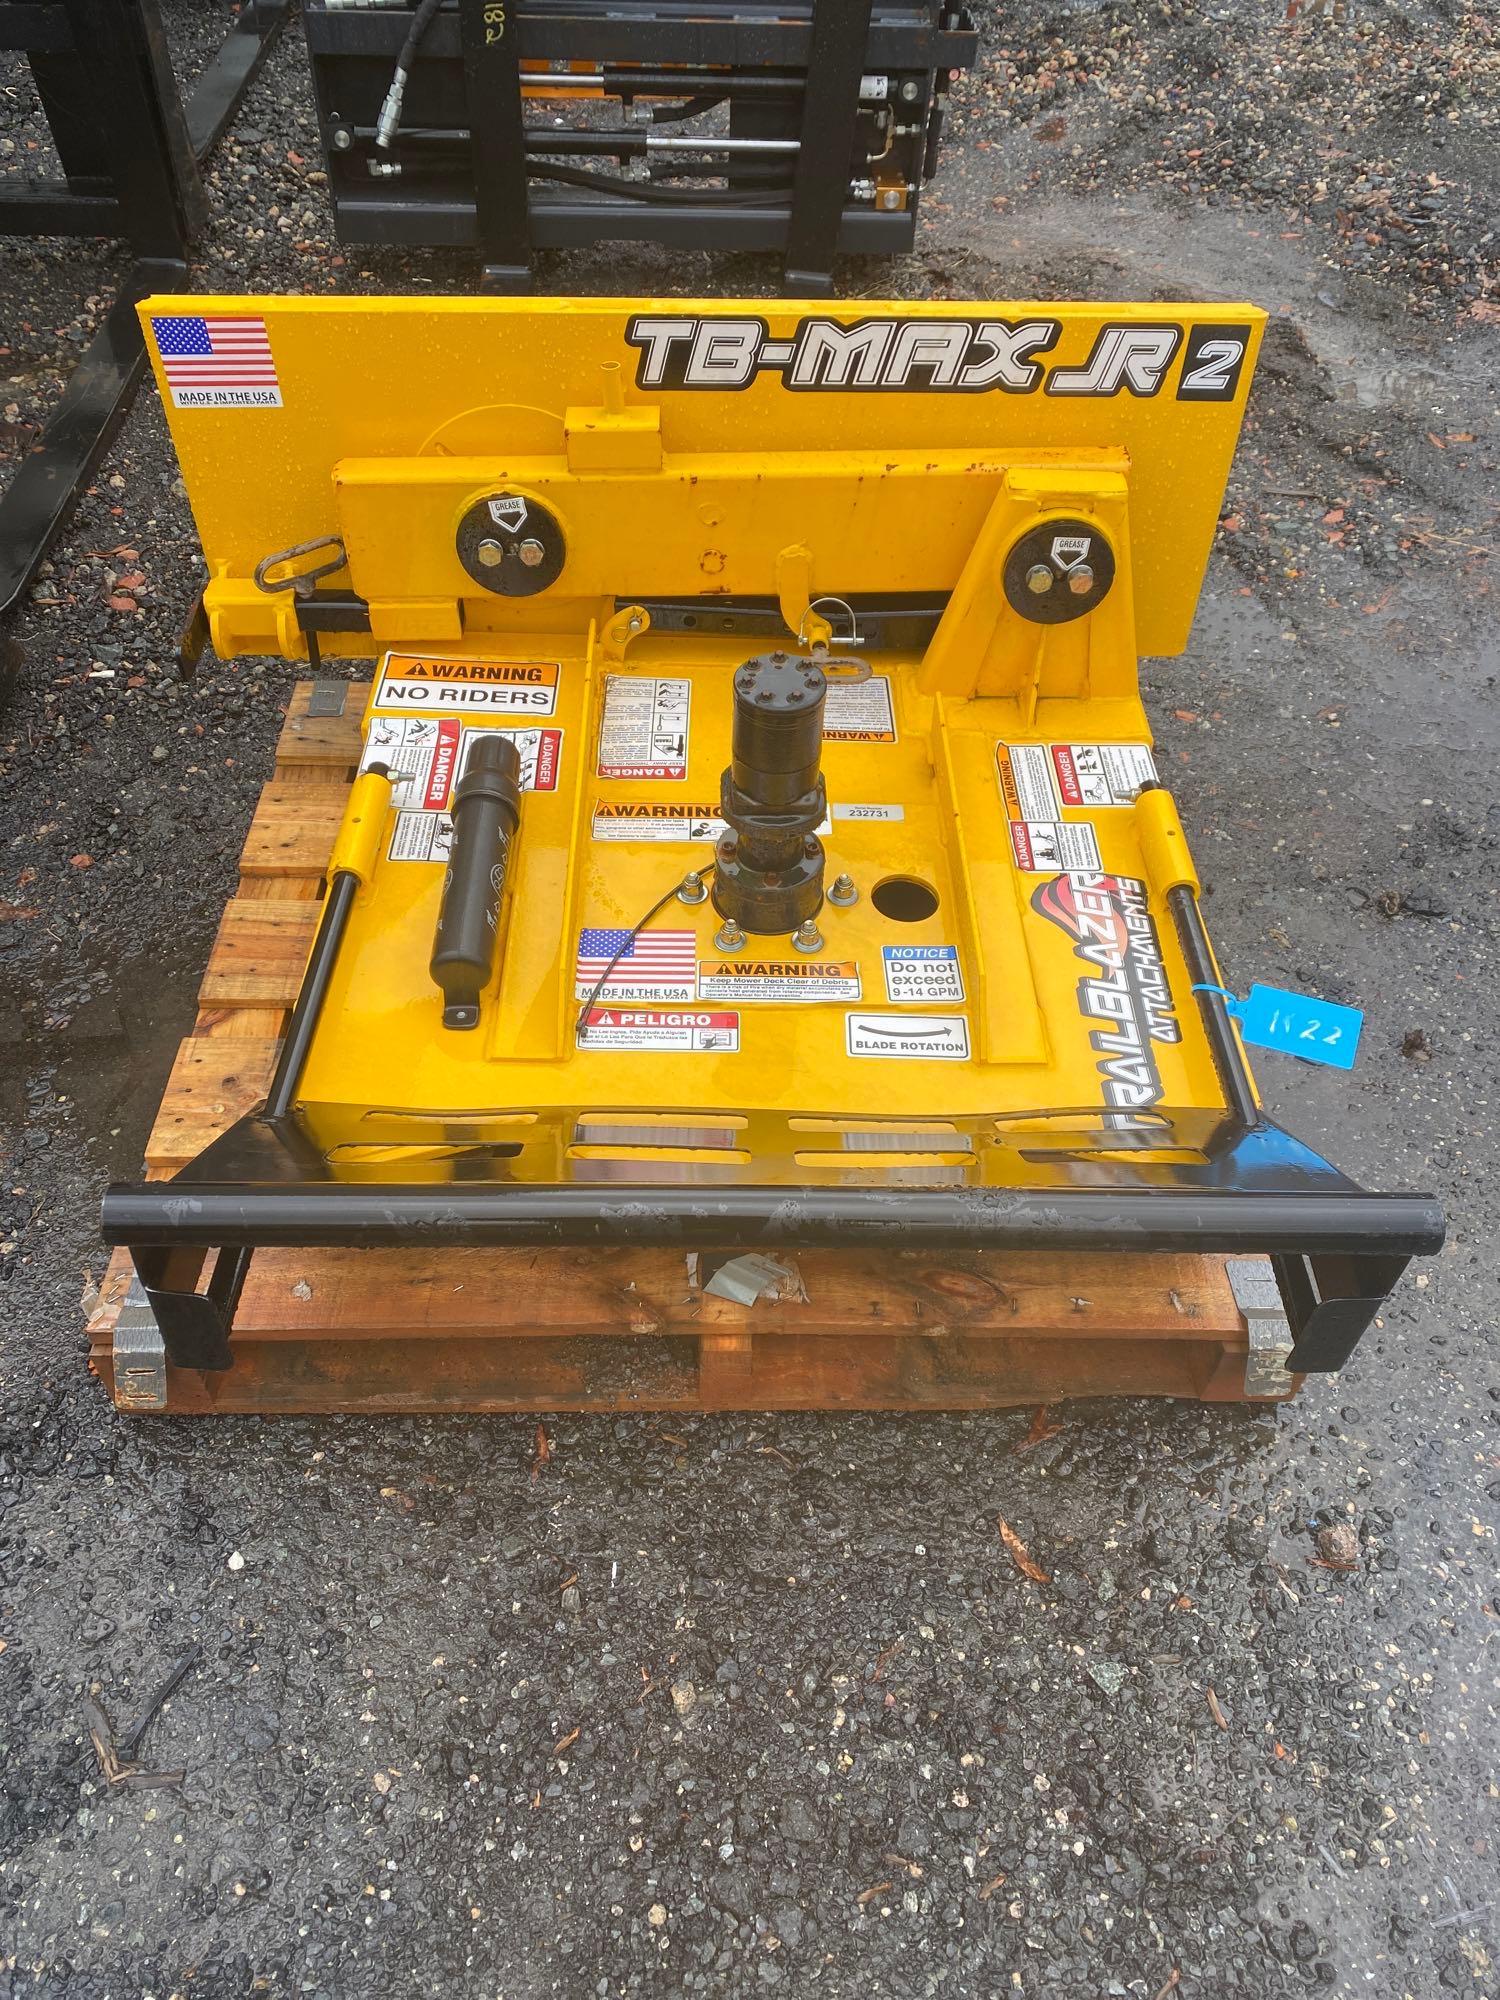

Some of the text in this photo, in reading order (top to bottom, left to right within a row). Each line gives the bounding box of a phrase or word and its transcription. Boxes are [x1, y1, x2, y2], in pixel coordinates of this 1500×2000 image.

[631, 317, 1243, 393] TB-MAX JR 2
[179, 391, 276, 401] MADE IN THE USA
[495, 501, 521, 511] GREASE
[1060, 540, 1086, 549] GREASE
[432, 664, 543, 682] WARNING
[386, 686, 549, 706] NO RIDERS
[540, 744, 554, 784] DANGER
[1058, 751, 1077, 790] DANGER
[429, 747, 453, 801] DANGER
[1001, 760, 1016, 799] WARNING
[1015, 825, 1029, 860] DANGER
[891, 948, 949, 958] NOTICE
[1117, 877, 1176, 1043] ATTACHMENTS
[734, 963, 841, 977] WARNING
[891, 962, 955, 974] Do not
[892, 974, 956, 986] exceed
[927, 987, 960, 997] GPM
[620, 1014, 712, 1026] PELIGRO
[855, 1040, 965, 1052] BLADE ROTATION
